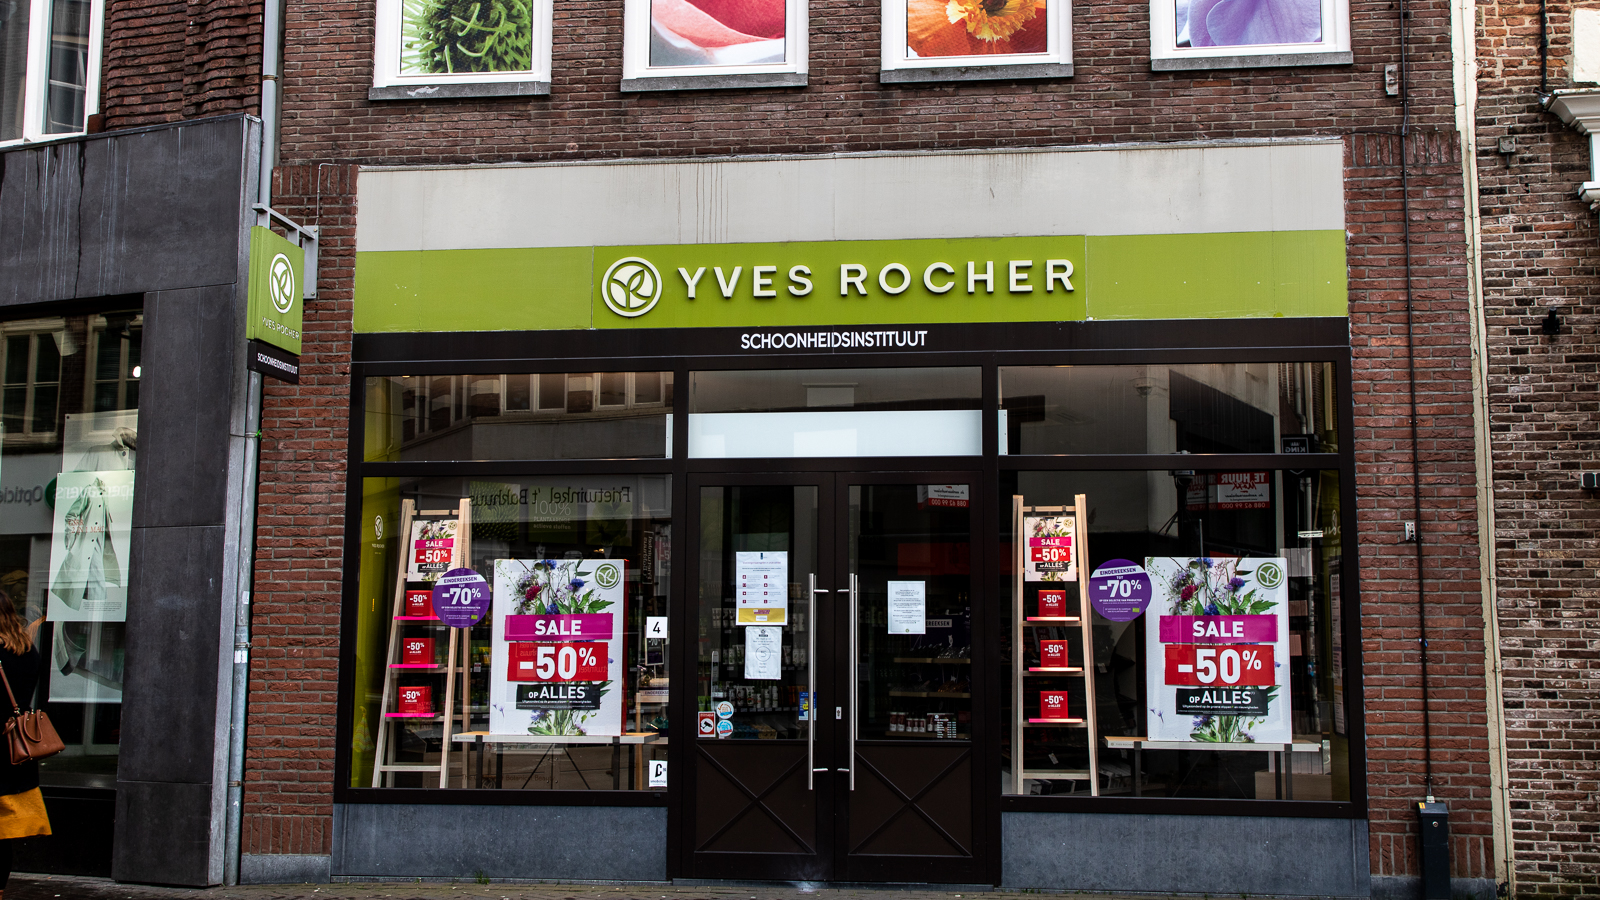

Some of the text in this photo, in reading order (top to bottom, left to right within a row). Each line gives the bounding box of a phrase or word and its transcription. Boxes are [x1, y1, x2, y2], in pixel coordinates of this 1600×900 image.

[678, 258, 1075, 299] YVES ROCHER
[262, 316, 300, 340] YVES ROCHER
[740, 330, 928, 350] SCHOONHEIDSINSTITUUT
[257, 352, 298, 375] SCHOONHEIDSINSTITUUT
[535, 499, 571, 516] 100%
[419, 550, 447, 562] -50%
[1035, 548, 1067, 561] -50%
[443, 576, 478, 584] EINDEREEKSEN
[1099, 567, 1137, 576] EINDEREEKSEN
[441, 587, 481, 605] -70%
[1098, 579, 1142, 598] -70%
[534, 619, 582, 636] SALE
[652, 621, 661, 634] 4
[1192, 621, 1244, 638] SALE
[407, 642, 424, 650] -50%
[519, 646, 597, 680] -50%
[1177, 648, 1262, 684] -50%
[402, 691, 420, 699] -50%
[528, 685, 586, 699] OP ALLES
[1188, 690, 1252, 704] OP ALLES
